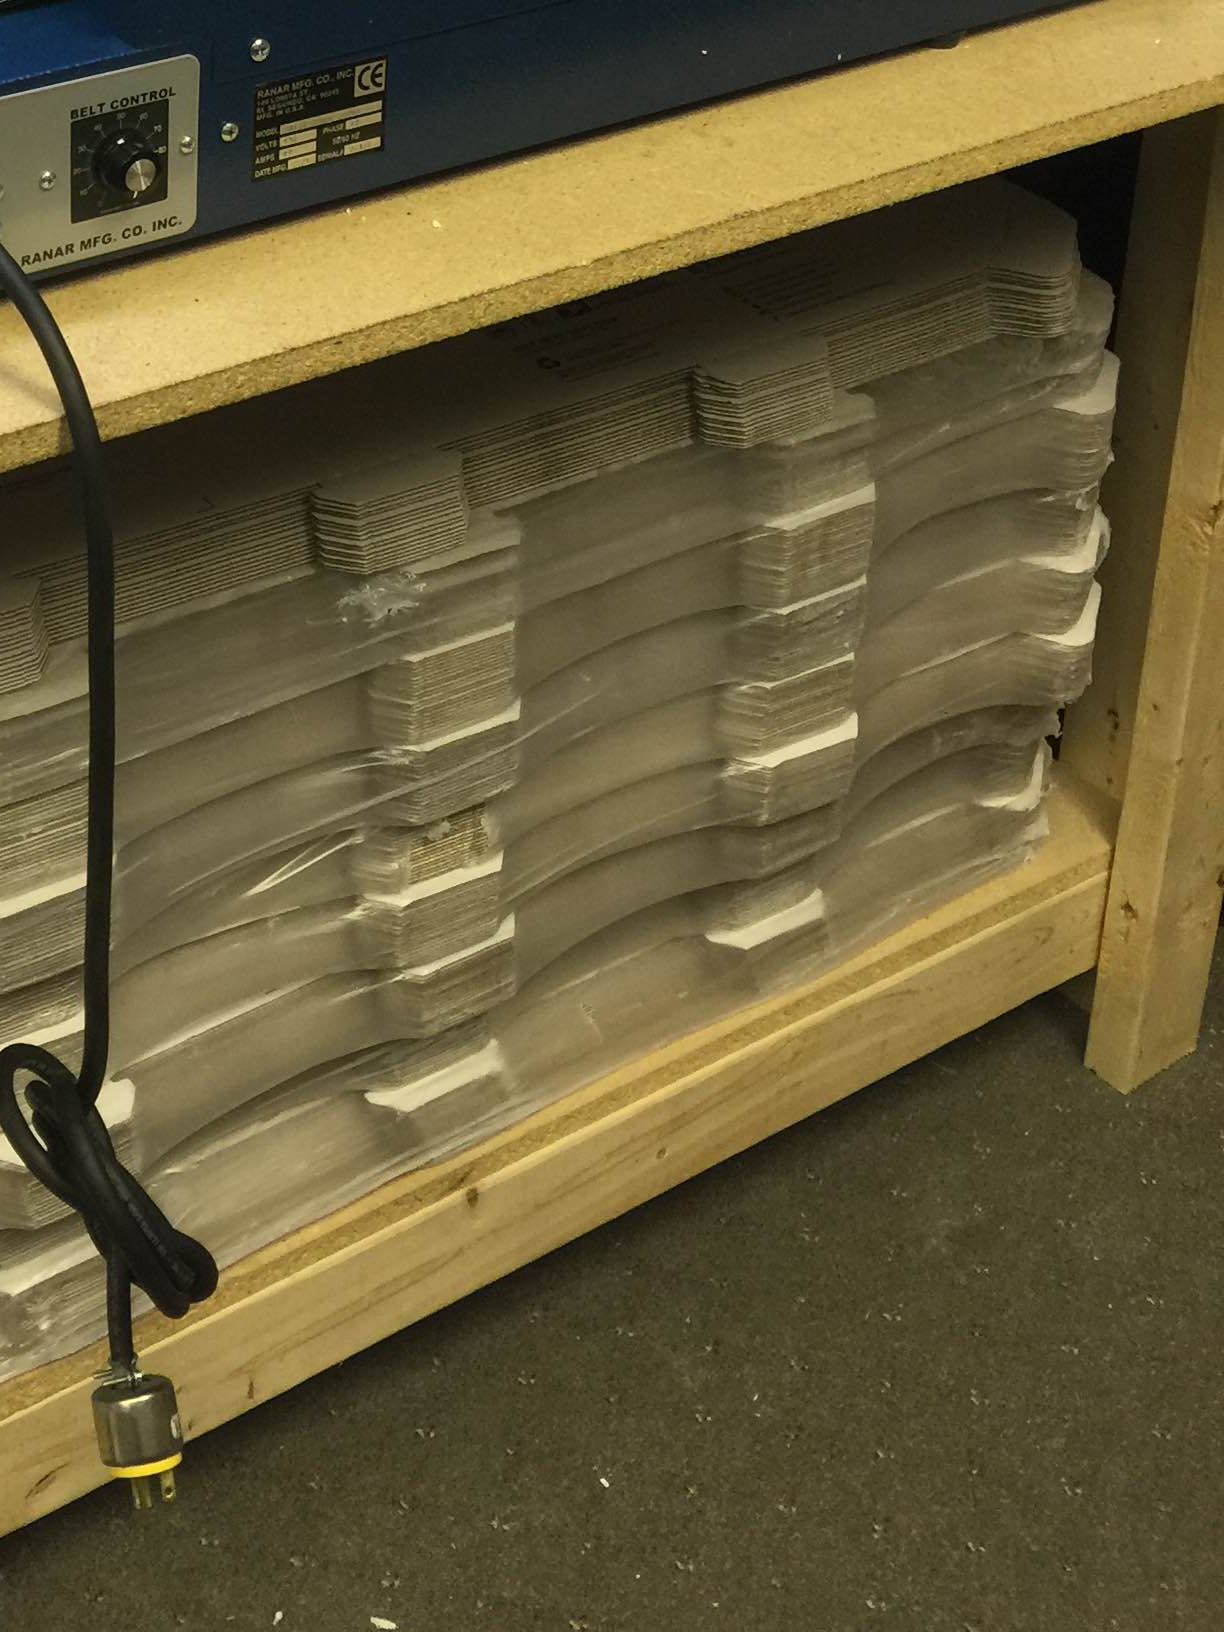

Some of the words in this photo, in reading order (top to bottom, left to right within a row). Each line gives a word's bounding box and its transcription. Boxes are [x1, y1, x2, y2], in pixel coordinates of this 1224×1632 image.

[358, 62, 383, 90] CE
[70, 104, 106, 120] BELT
[109, 87, 176, 111] CONTROL
[257, 84, 290, 99] RANAR
[20, 240, 75, 267] RANAR
[79, 232, 115, 252] MFG.
[121, 224, 148, 241] CO.
[152, 216, 183, 236] INC.
